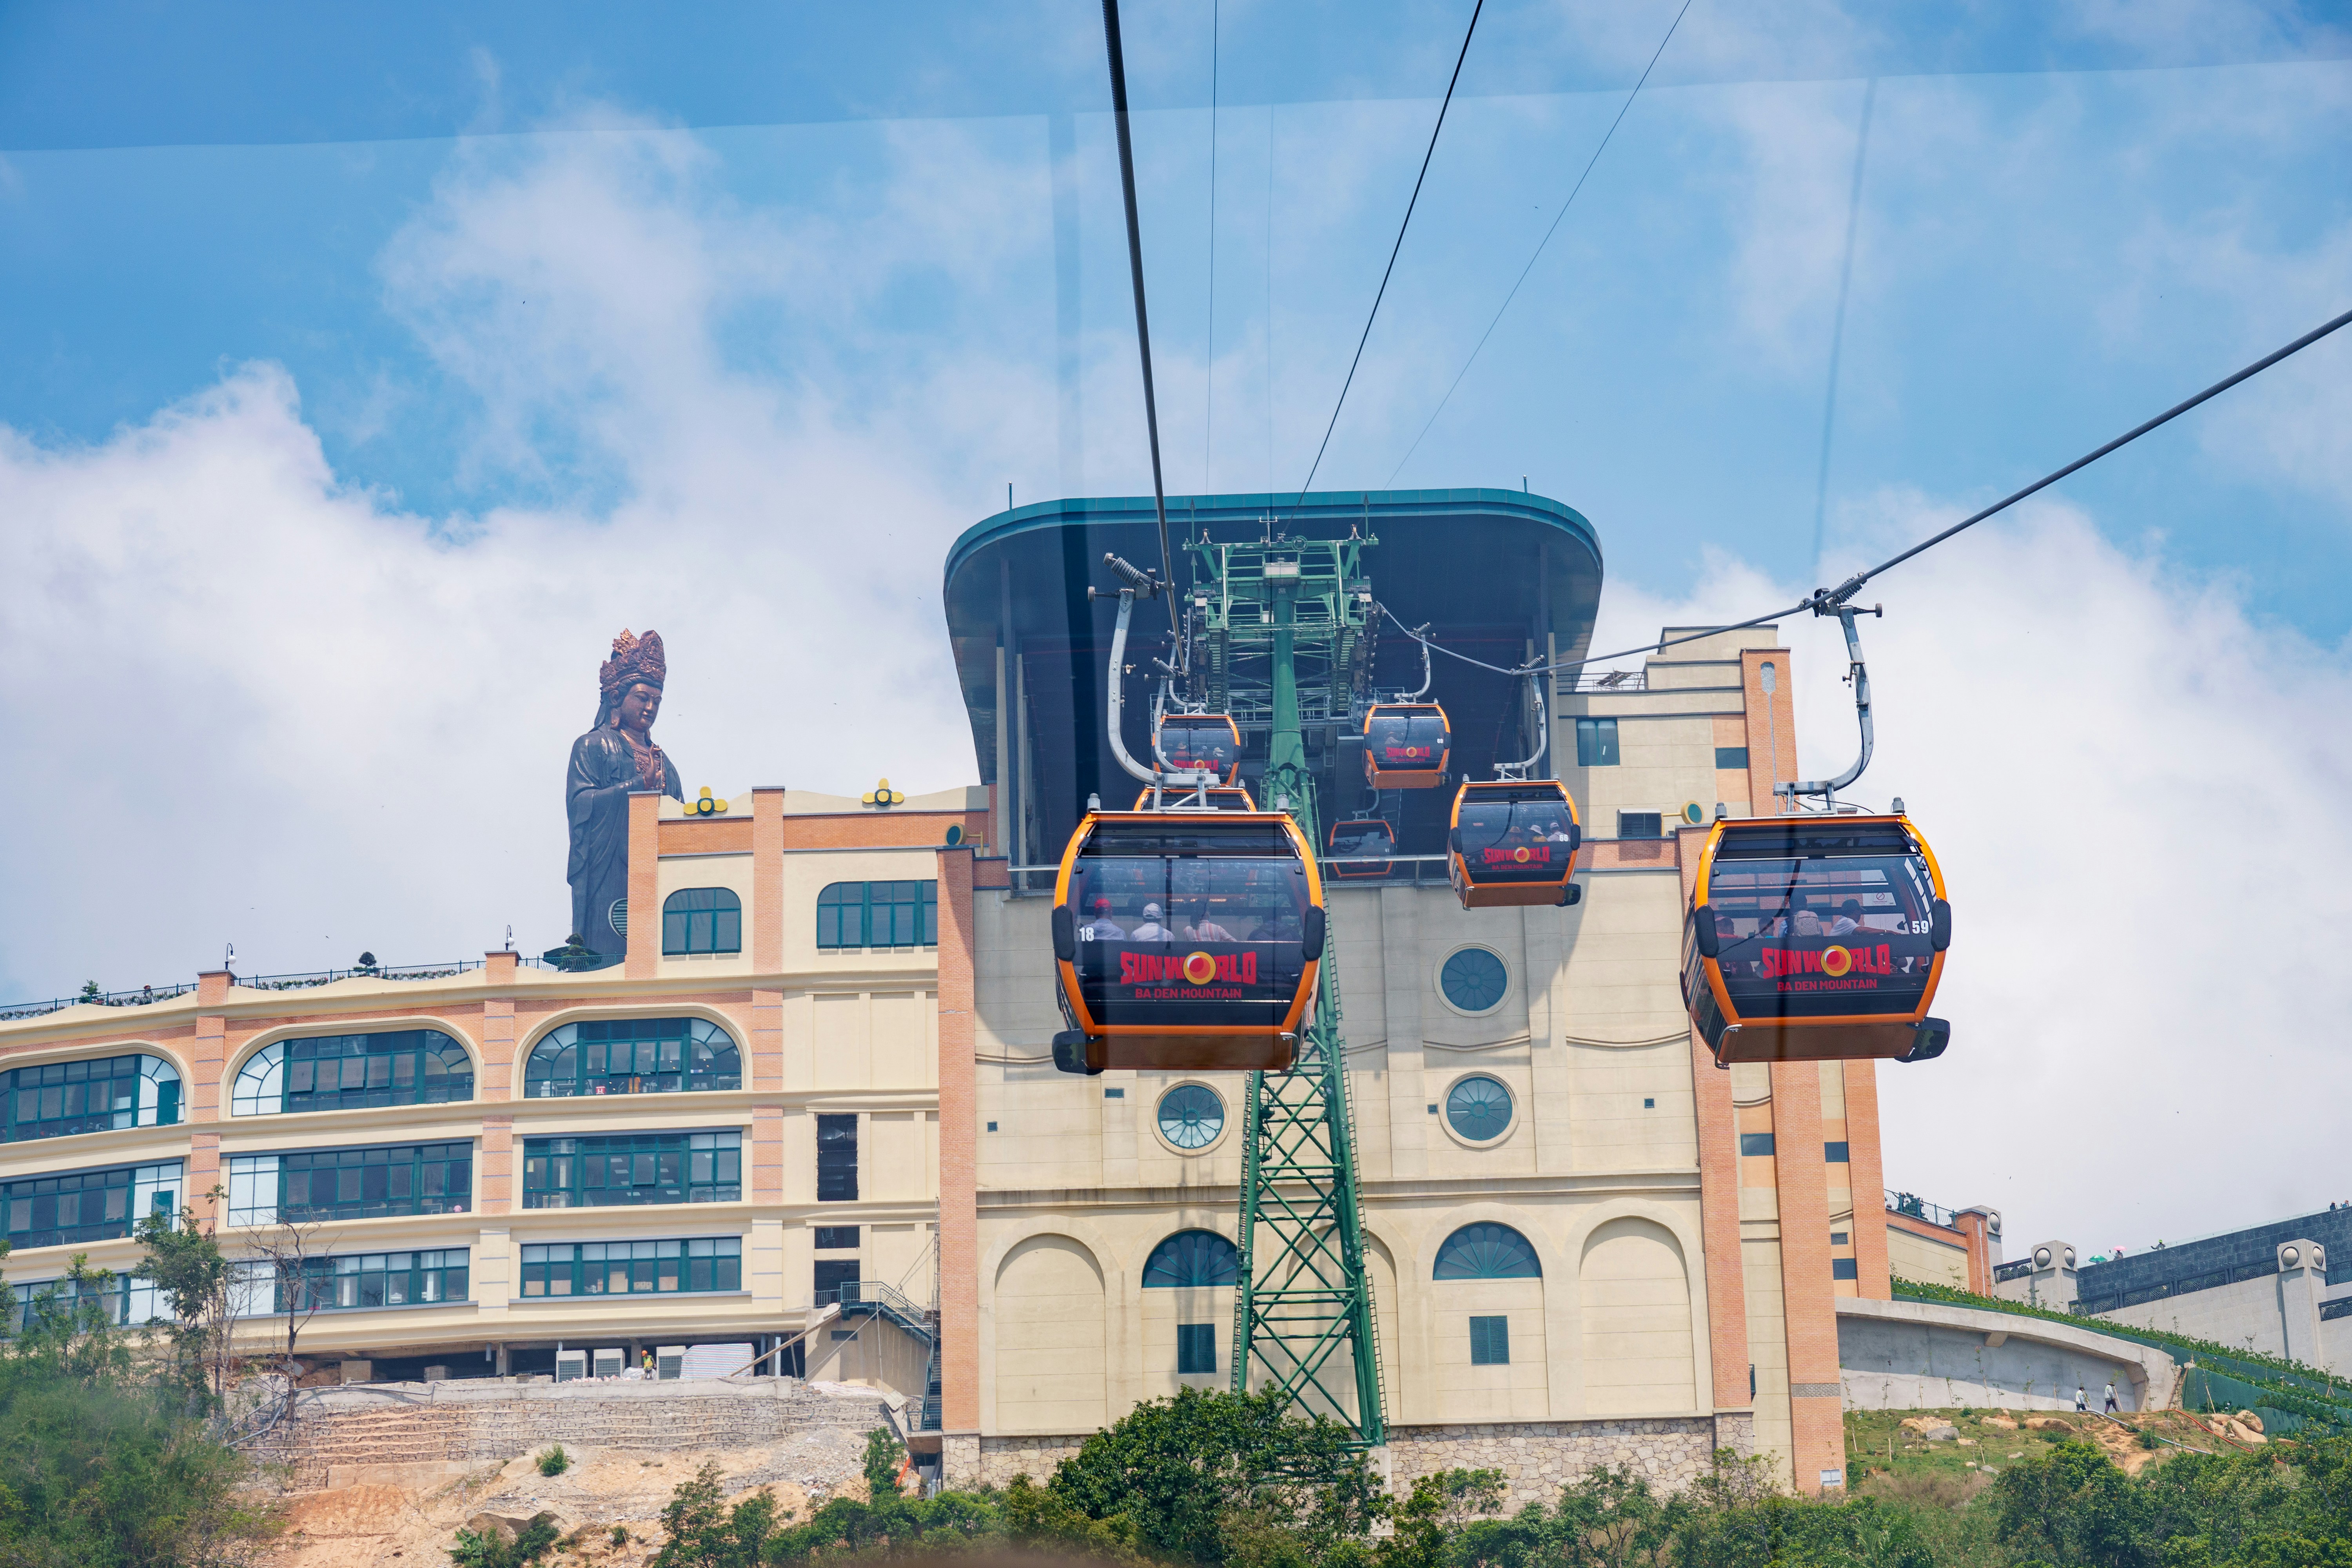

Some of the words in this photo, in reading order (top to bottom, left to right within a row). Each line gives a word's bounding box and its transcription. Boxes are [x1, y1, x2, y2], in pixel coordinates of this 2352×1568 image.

[1484, 846, 1550, 864] SUNWORLD
[1079, 927, 1094, 942] 18
[1912, 920, 1929, 934] 59
[1120, 951, 1256, 985] SUNWORLD
[1762, 944, 1890, 979] SUNWORLD
[1777, 981, 1793, 991] BA
[1795, 981, 1817, 991] DEN
[1820, 979, 1877, 990] MOUNTAIN
[1135, 988, 1152, 998] BA
[1154, 988, 1178, 998] DEN
[1181, 988, 1241, 998] MOUNTAIN
